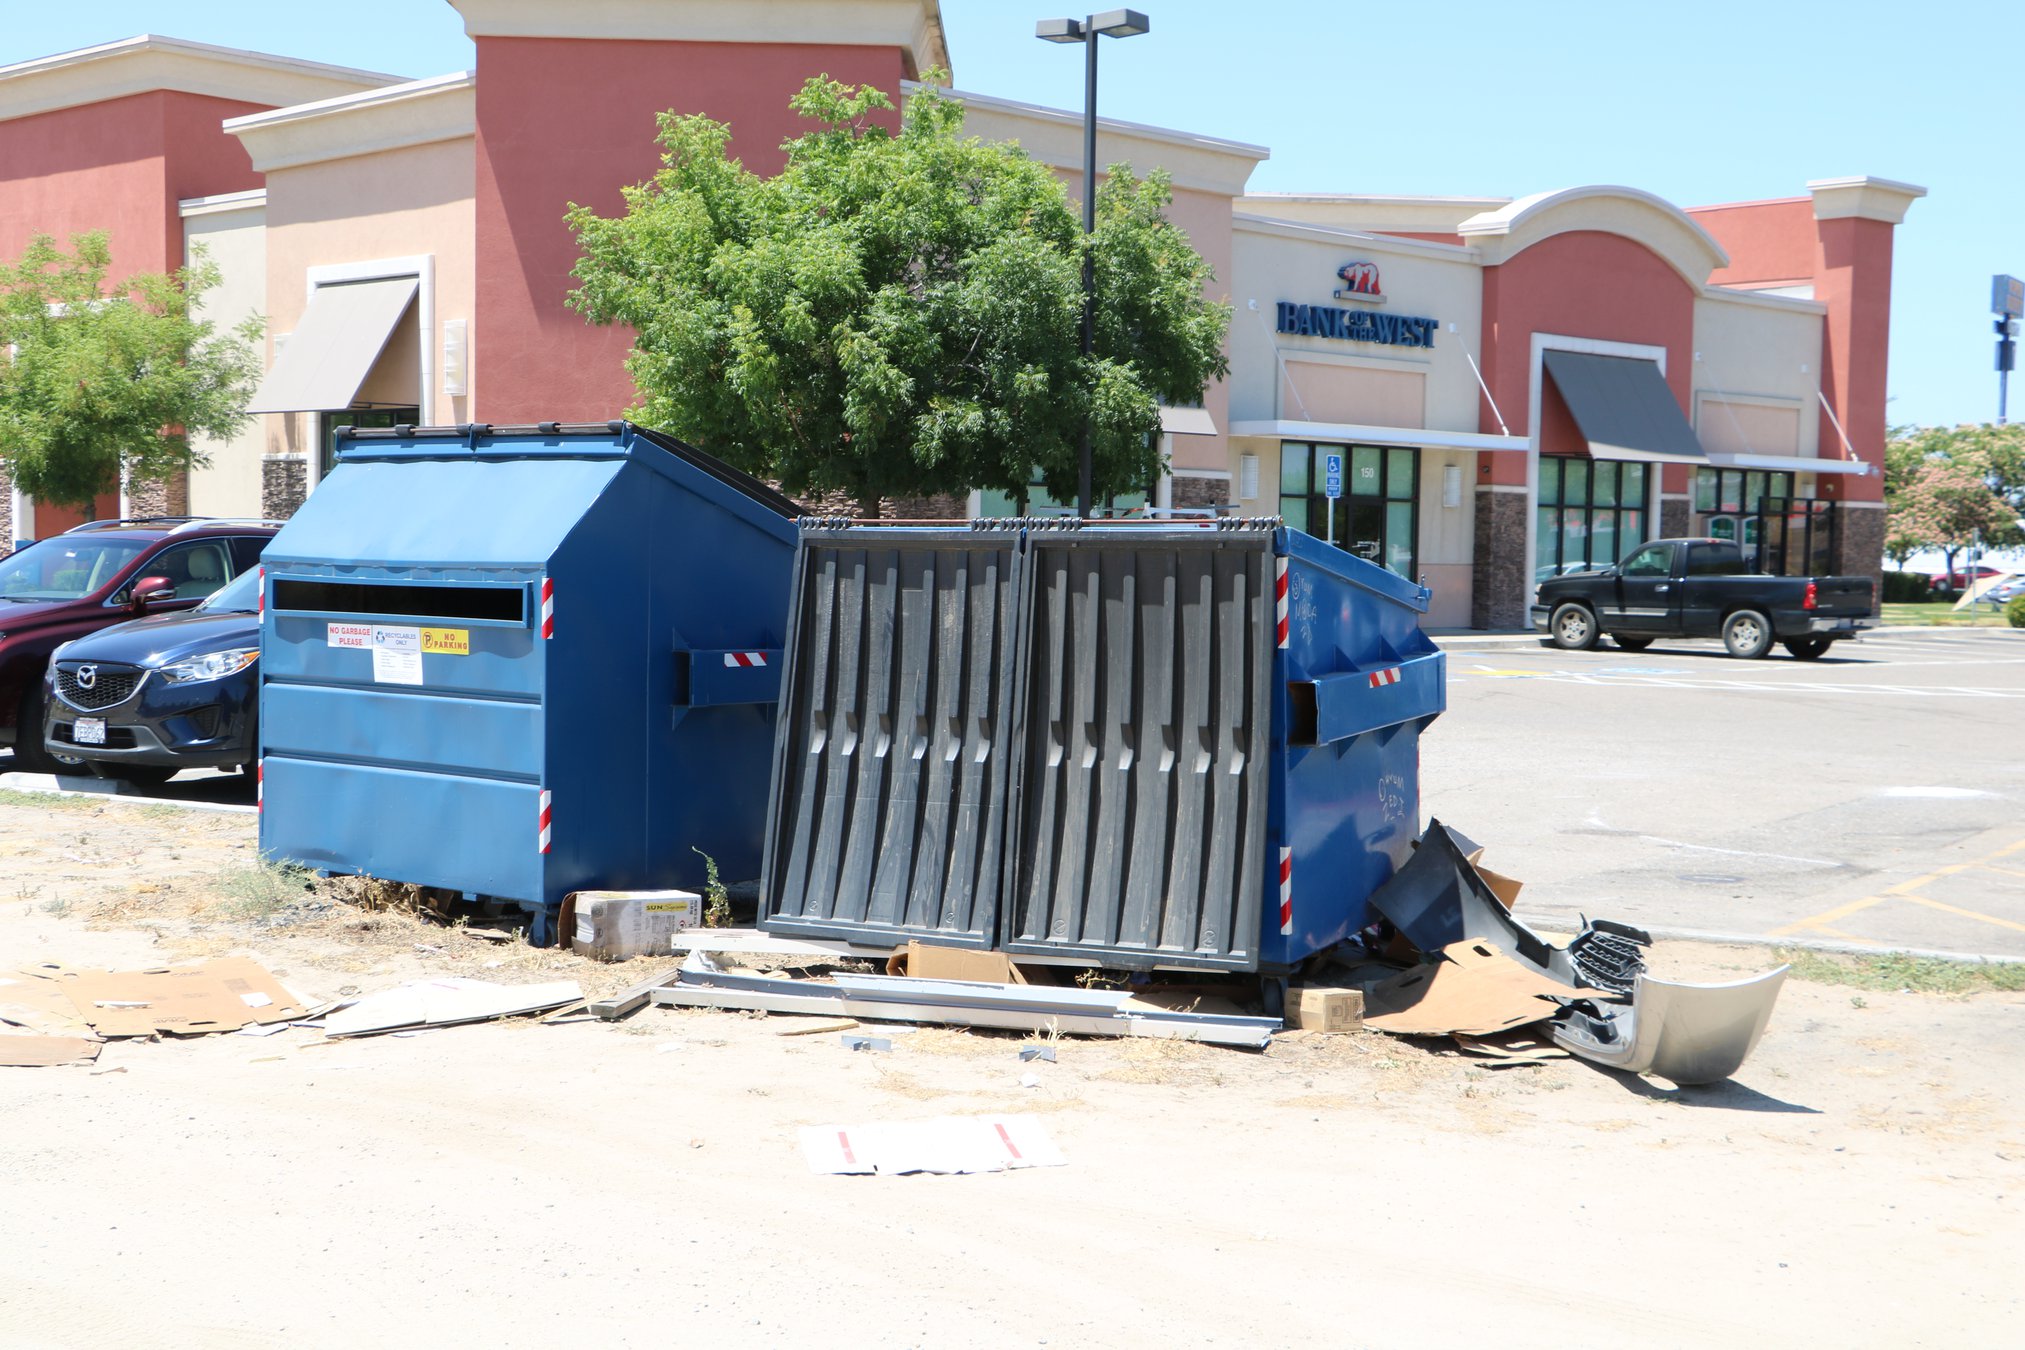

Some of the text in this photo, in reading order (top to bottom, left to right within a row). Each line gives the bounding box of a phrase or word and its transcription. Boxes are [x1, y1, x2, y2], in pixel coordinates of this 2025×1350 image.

[1276, 302, 1439, 348] BANK OF THE WEST
[1361, 467, 1374, 478] 150
[329, 626, 371, 636] NO GARBAGE
[385, 632, 417, 640] RECYCLABLES
[338, 637, 363, 646] PLEASE
[444, 633, 455, 641] NO
[433, 640, 468, 650] PARKING
